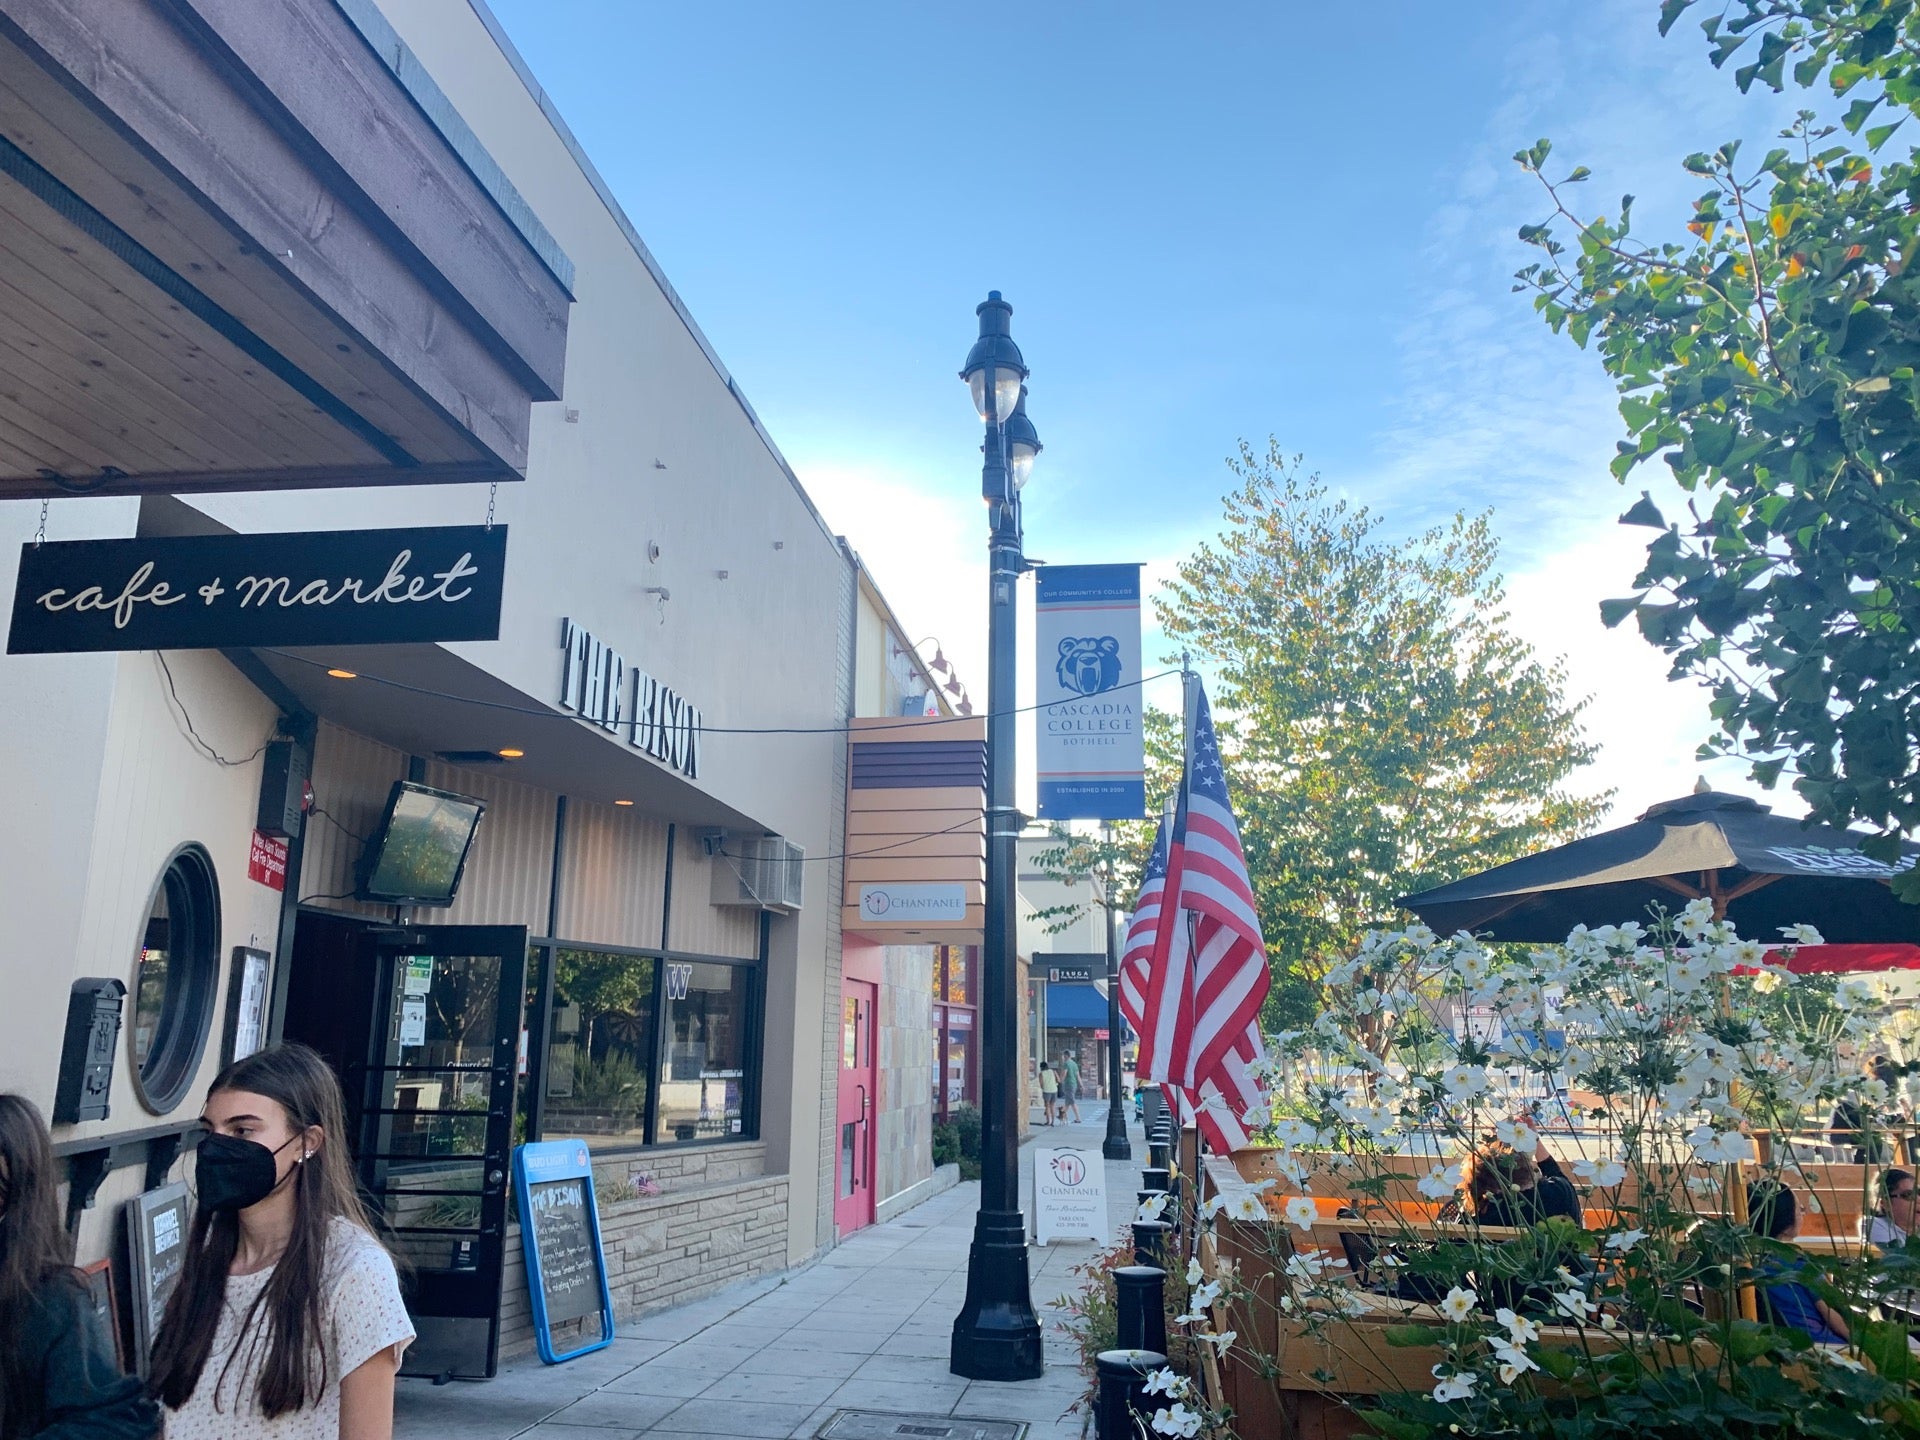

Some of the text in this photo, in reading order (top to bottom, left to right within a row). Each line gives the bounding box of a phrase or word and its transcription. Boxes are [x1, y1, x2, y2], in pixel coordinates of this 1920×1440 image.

[36, 560, 186, 629] cafe
[235, 548, 478, 608] market
[1058, 589, 1102, 597] COMMUNITY'S
[559, 617, 703, 779] THE BISON
[1047, 703, 1133, 717] CASCADIA
[1047, 719, 1133, 732] COLLEGE
[1063, 736, 1117, 746] BOTHELL
[1056, 786, 1100, 794] ESTABLISHED
[891, 898, 960, 909] CHANTANEE
[666, 964, 692, 1000] W
[527, 1154, 569, 1169] BUD LIGHT
[548, 1184, 583, 1210] BISON
[1041, 1186, 1101, 1197] CHANTANEE
